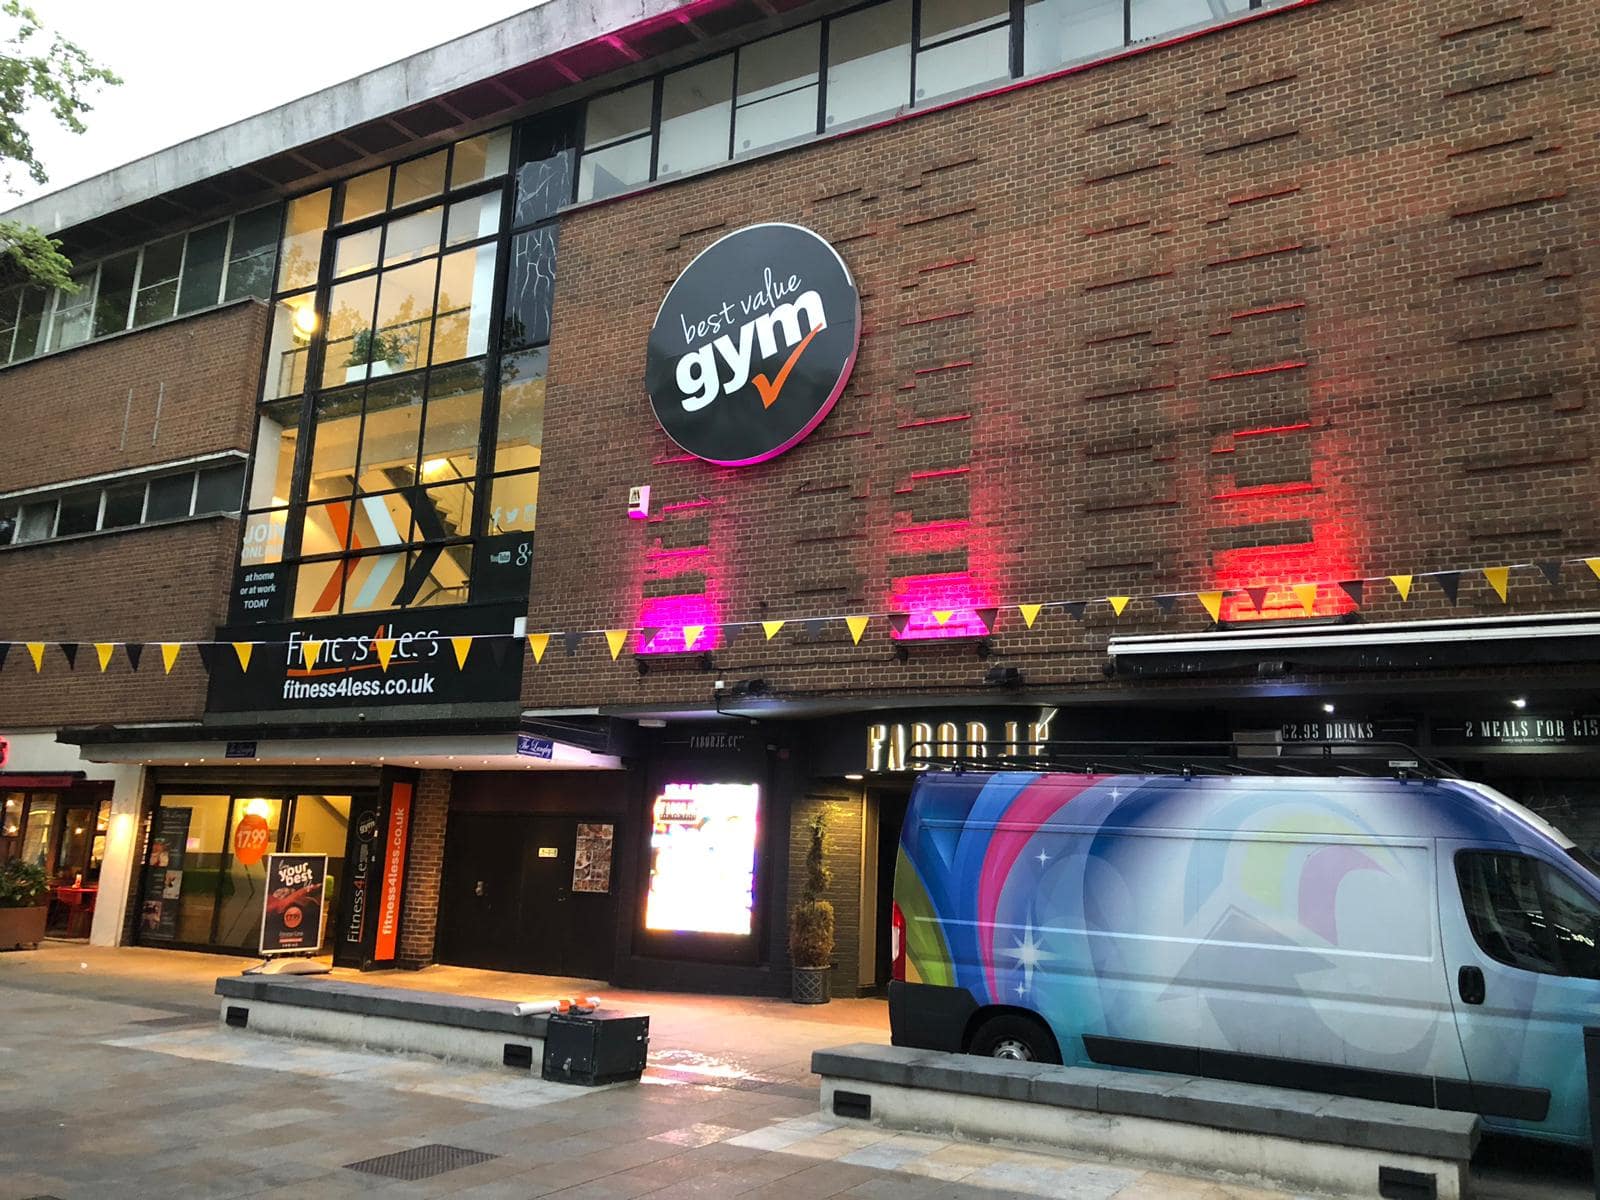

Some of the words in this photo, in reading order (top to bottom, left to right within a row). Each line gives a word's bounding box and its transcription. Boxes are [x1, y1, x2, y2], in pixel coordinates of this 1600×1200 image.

[680, 301, 736, 345] best
[740, 266, 802, 316] value
[675, 290, 828, 413] gym
[244, 573, 253, 582] at
[253, 572, 275, 582] home
[240, 586, 248, 595] or
[248, 585, 256, 594] at
[257, 583, 276, 593] work
[243, 599, 269, 609] TODAY
[286, 624, 440, 666] Fines4Les
[283, 673, 436, 700] fitness4less.co.uk
[1325, 722, 1374, 739] DRINKS
[1465, 721, 1473, 737] 2
[1481, 720, 1529, 737] MEALS
[1536, 720, 1565, 737] FOR
[237, 829, 267, 849] 17.99
[278, 861, 309, 882] your
[285, 869, 313, 887] best
[381, 807, 405, 936] fitness4less.co.uk
[347, 843, 369, 943] Fitness4Le
